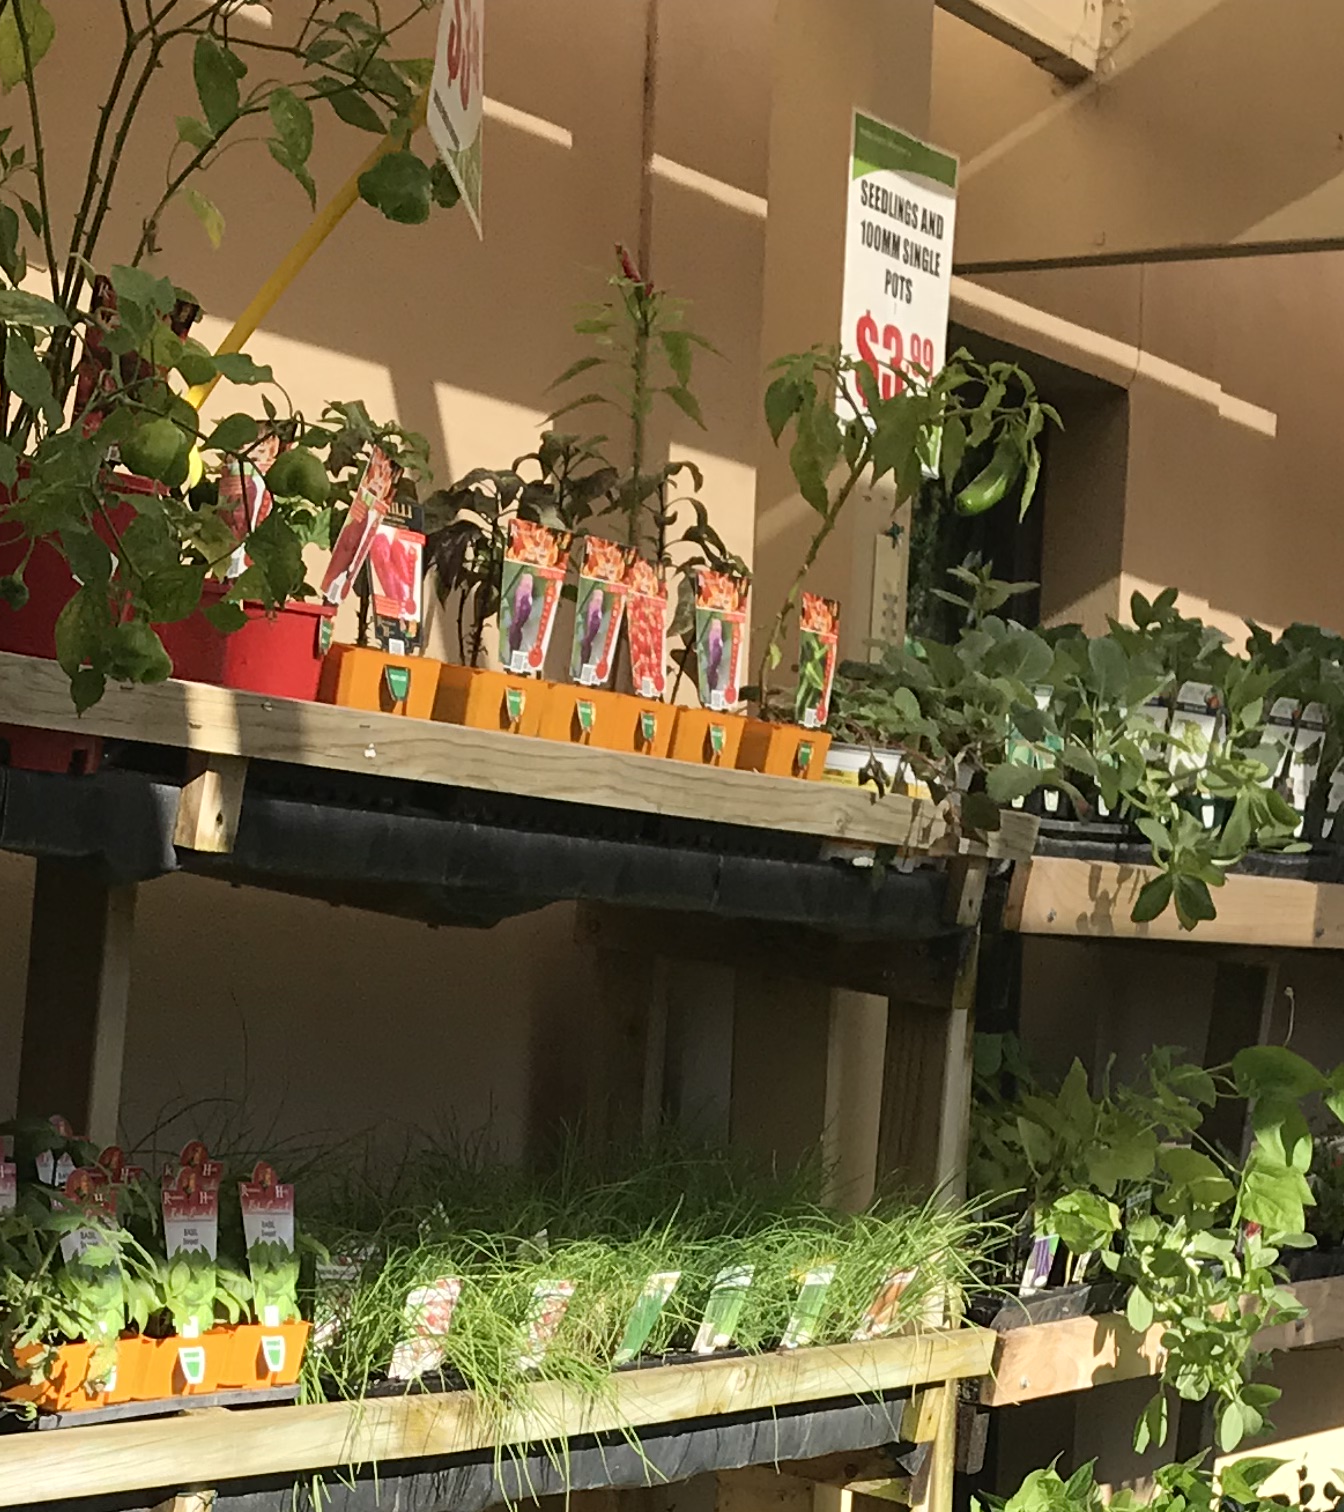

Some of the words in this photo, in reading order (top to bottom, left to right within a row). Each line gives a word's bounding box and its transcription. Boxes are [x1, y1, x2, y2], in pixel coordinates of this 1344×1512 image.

[860, 179, 919, 231] SEEDLINGS
[920, 209, 945, 241] AND
[860, 219, 901, 261] 100MM
[902, 238, 942, 278] SINGLE
[884, 268, 914, 305] POTS
